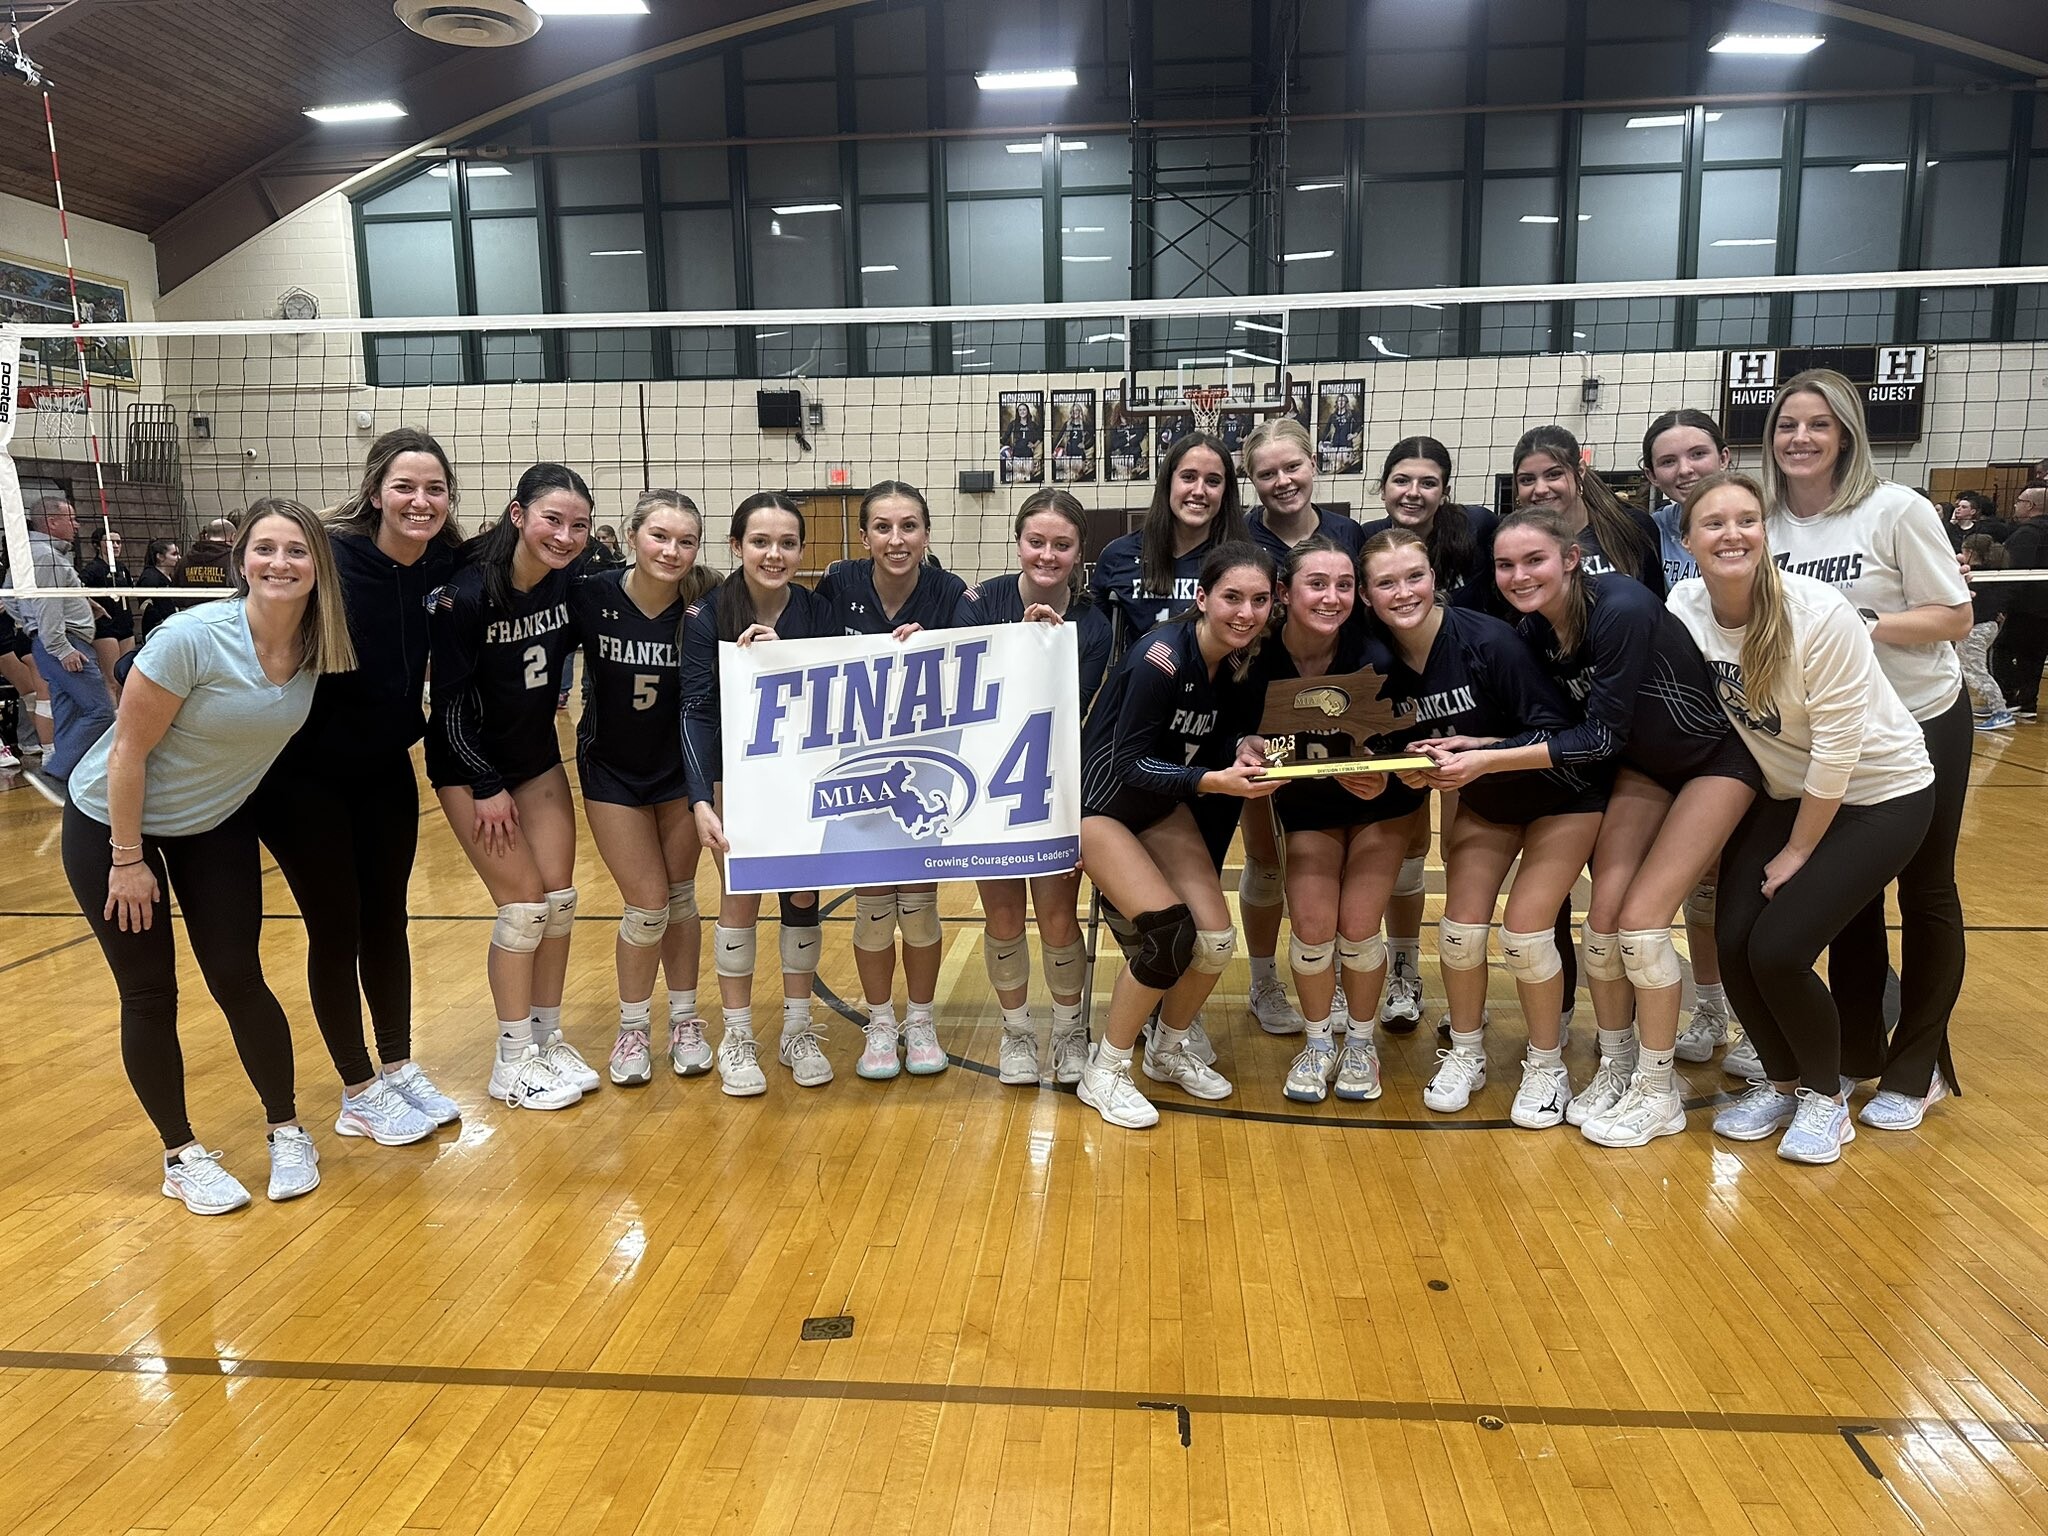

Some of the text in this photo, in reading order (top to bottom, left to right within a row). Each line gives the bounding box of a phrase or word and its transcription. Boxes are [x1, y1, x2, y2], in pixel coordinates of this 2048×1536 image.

[1738, 354, 1767, 384] H
[1886, 350, 1916, 381] H
[1731, 389, 1779, 405] HAVER
[1868, 386, 1916, 402] GUEST
[522, 644, 549, 690] 2
[632, 673, 661, 711] 5
[745, 638, 1001, 758] FINAL
[987, 710, 1053, 827] 4
[817, 778, 896, 810] MIAA
[924, 857, 969, 868] Growing
[971, 855, 1035, 866] Courageous
